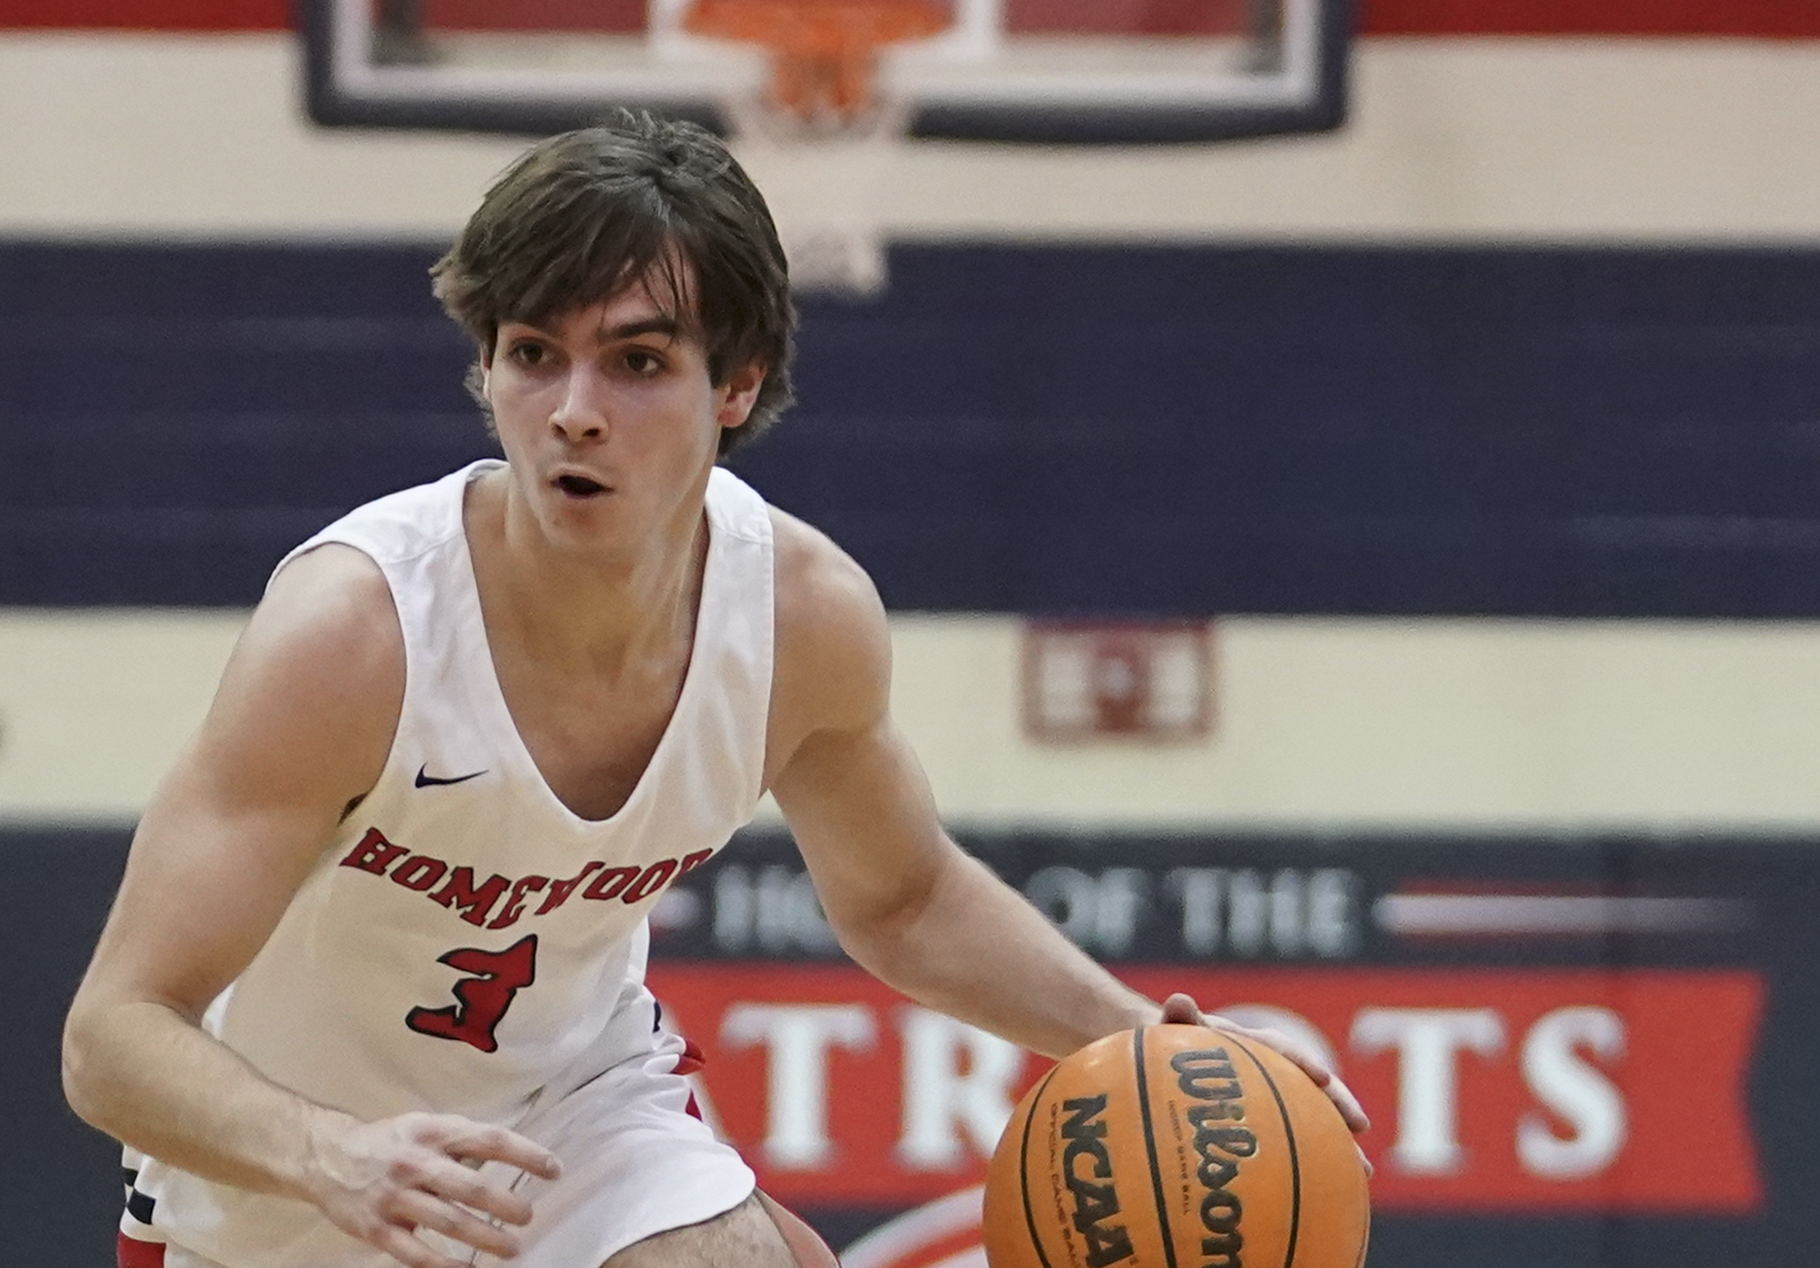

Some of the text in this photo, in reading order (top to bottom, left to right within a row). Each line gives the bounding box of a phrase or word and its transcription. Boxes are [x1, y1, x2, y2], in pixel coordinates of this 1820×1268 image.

[1026, 867, 1144, 954] OF
[1166, 868, 1358, 956] THE
[405, 934, 538, 1053] 3
